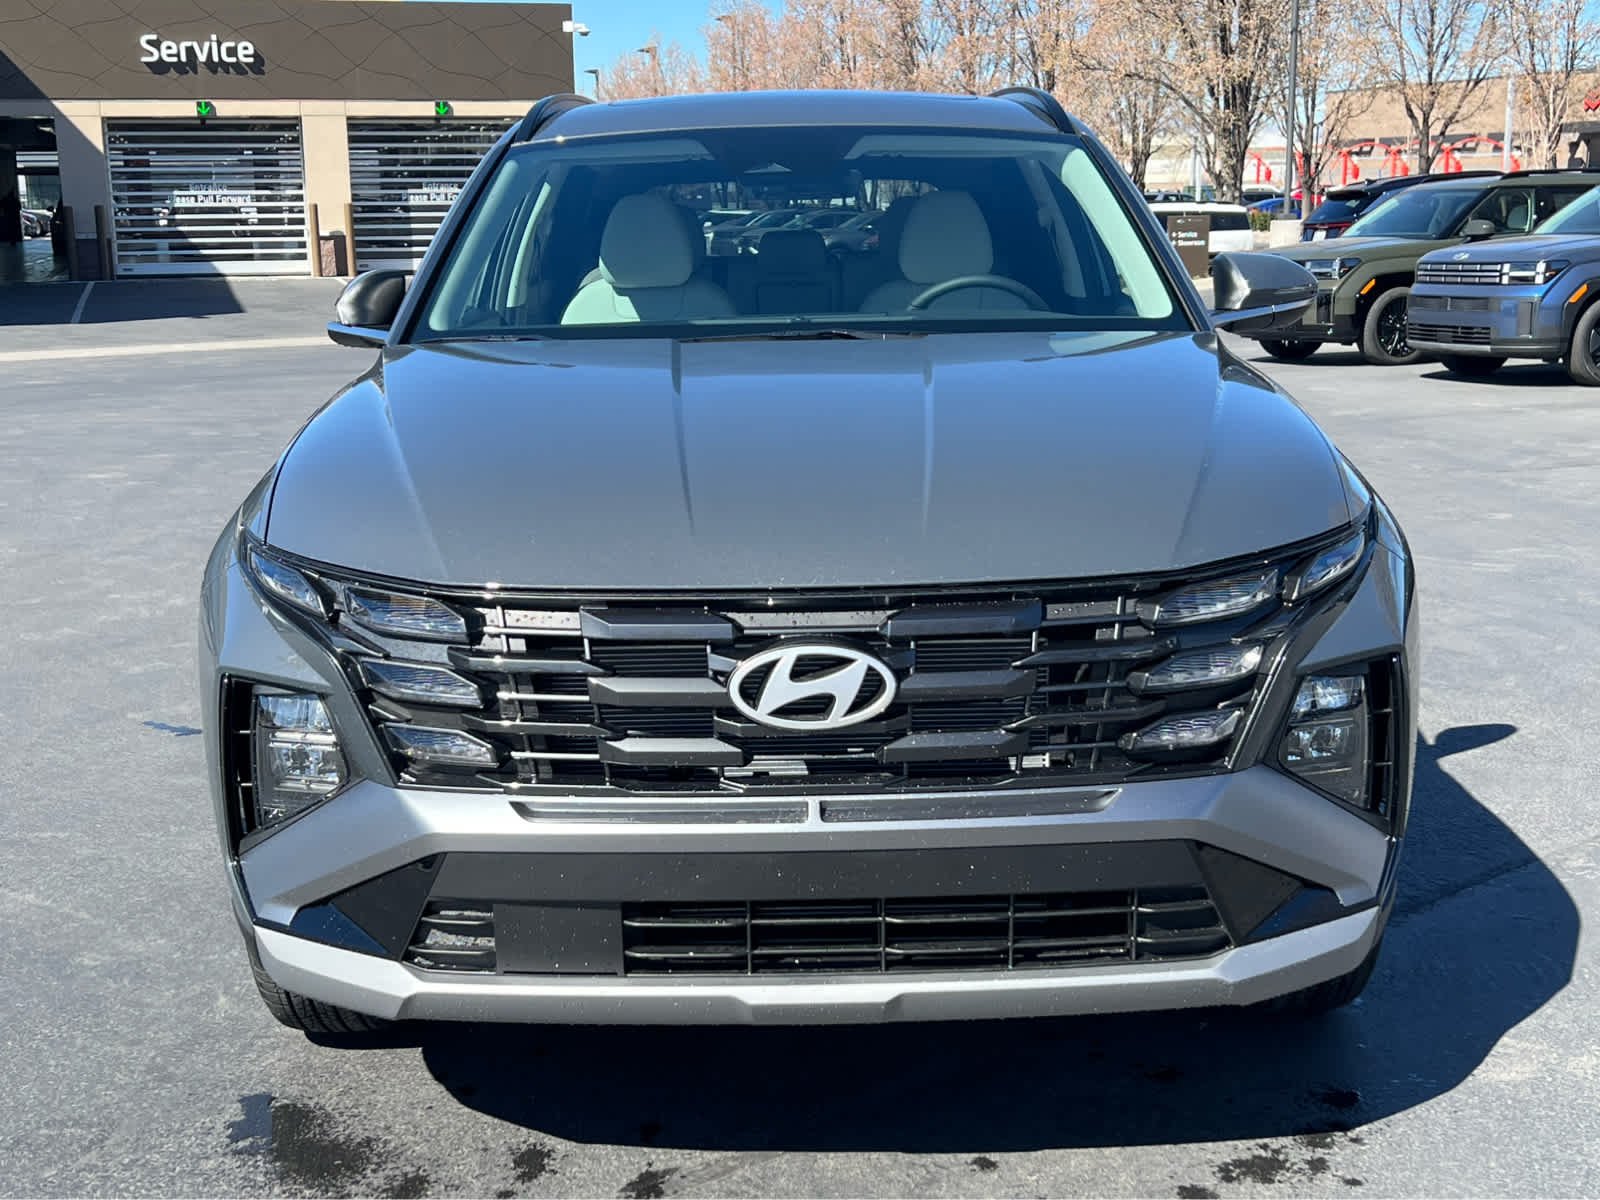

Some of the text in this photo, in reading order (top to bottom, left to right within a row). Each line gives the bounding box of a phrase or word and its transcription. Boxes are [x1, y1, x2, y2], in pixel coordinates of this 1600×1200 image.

[139, 33, 255, 63] Service
[197, 194, 214, 204] Pull
[216, 194, 251, 204] Forward
[430, 192, 446, 202] Pull
